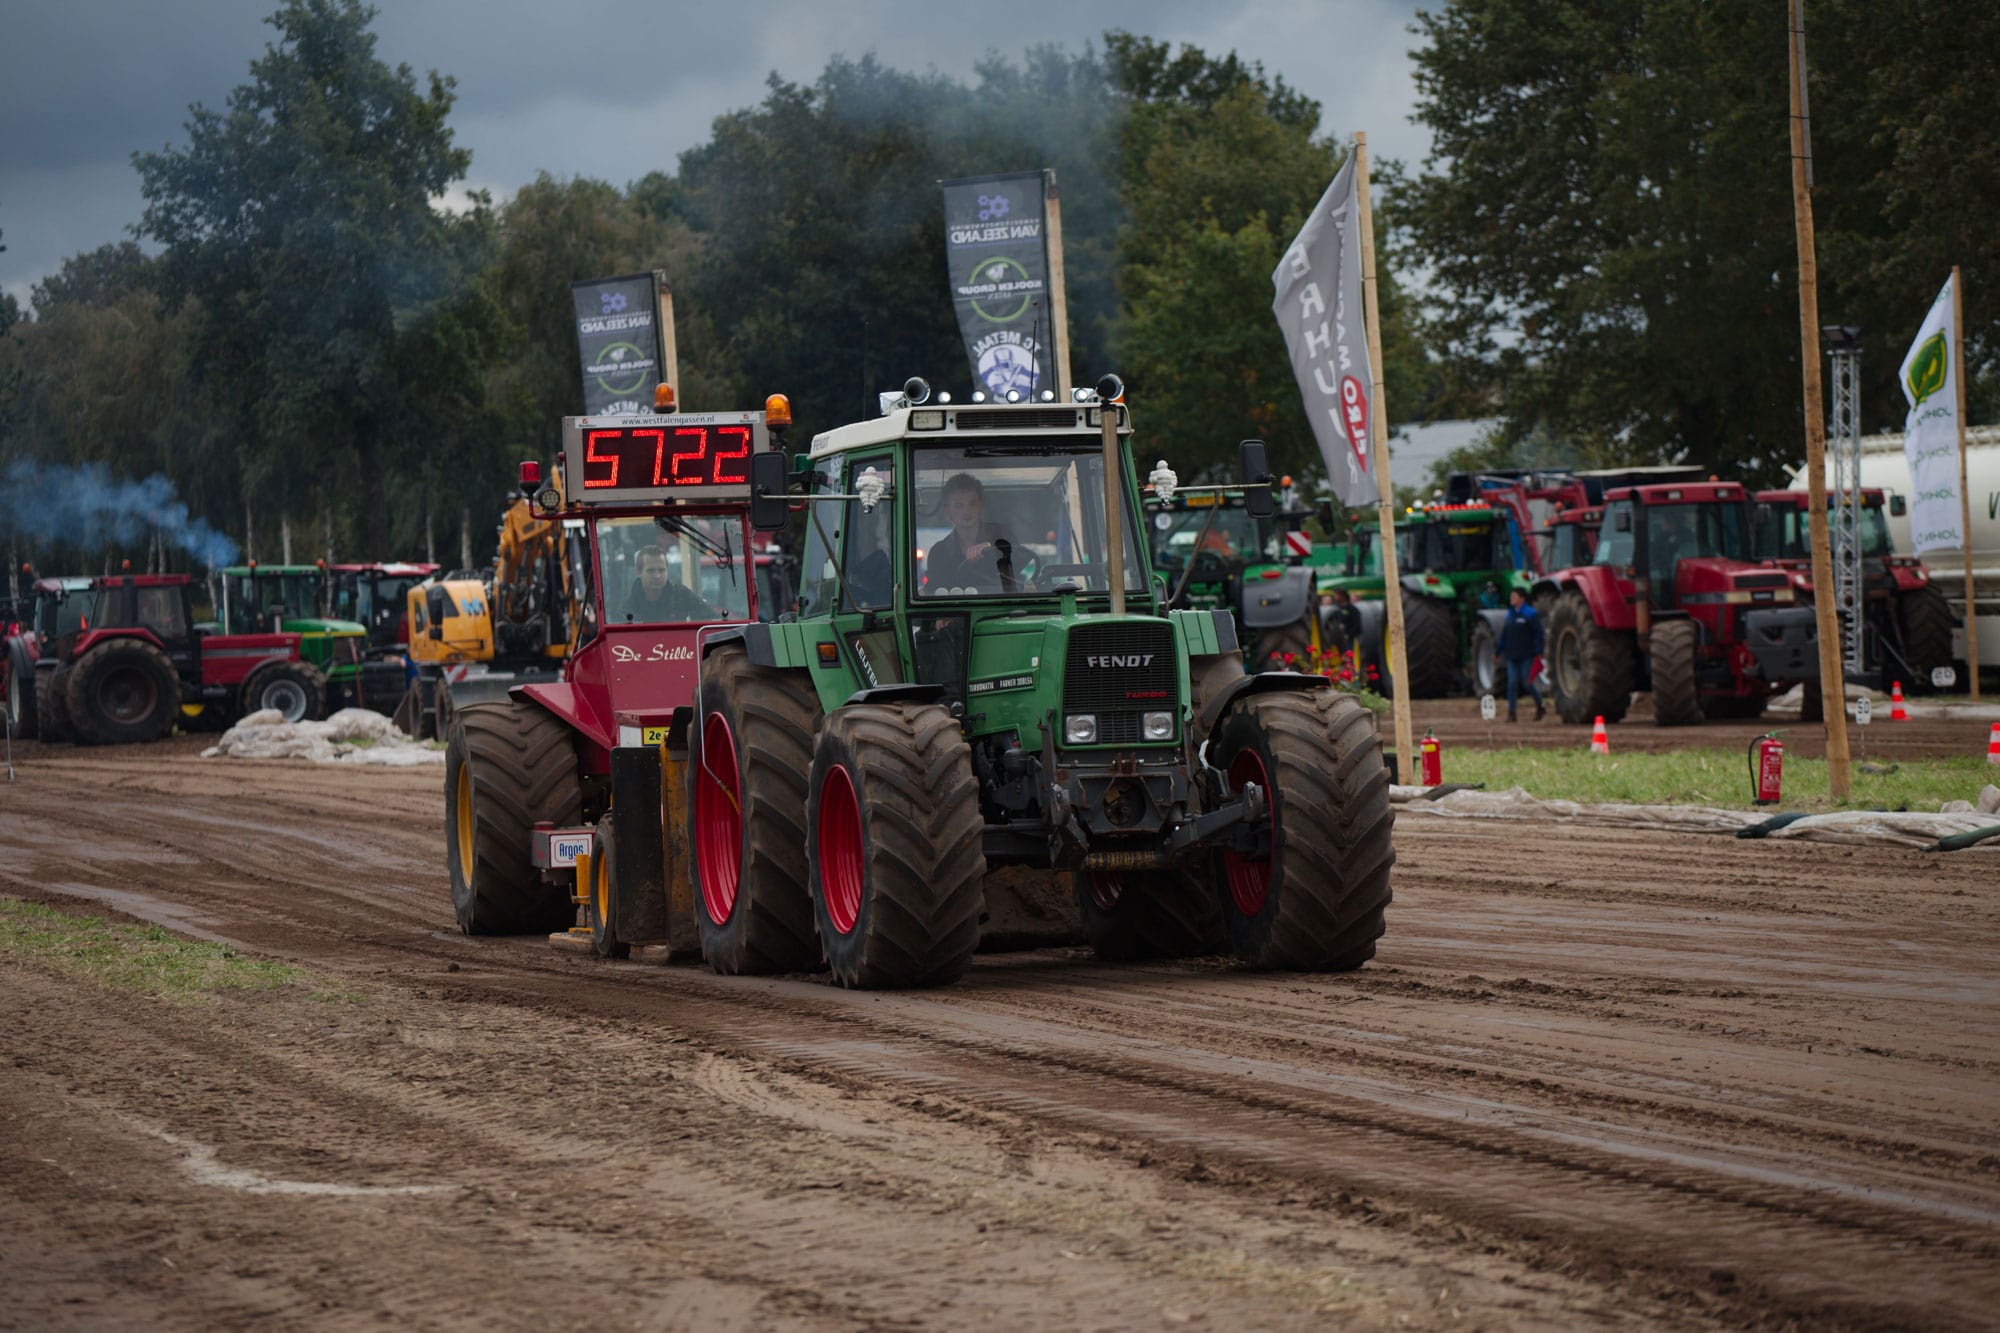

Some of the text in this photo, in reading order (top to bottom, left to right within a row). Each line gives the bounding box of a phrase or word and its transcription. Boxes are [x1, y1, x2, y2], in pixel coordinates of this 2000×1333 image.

[621, 415, 716, 426] www.westfalengassen.nl
[584, 426, 750, 489] 57.22
[612, 643, 694, 663] De Stille
[1086, 654, 1155, 668] FENDT
[649, 730, 662, 741] 2e
[559, 842, 584, 860] Argos
